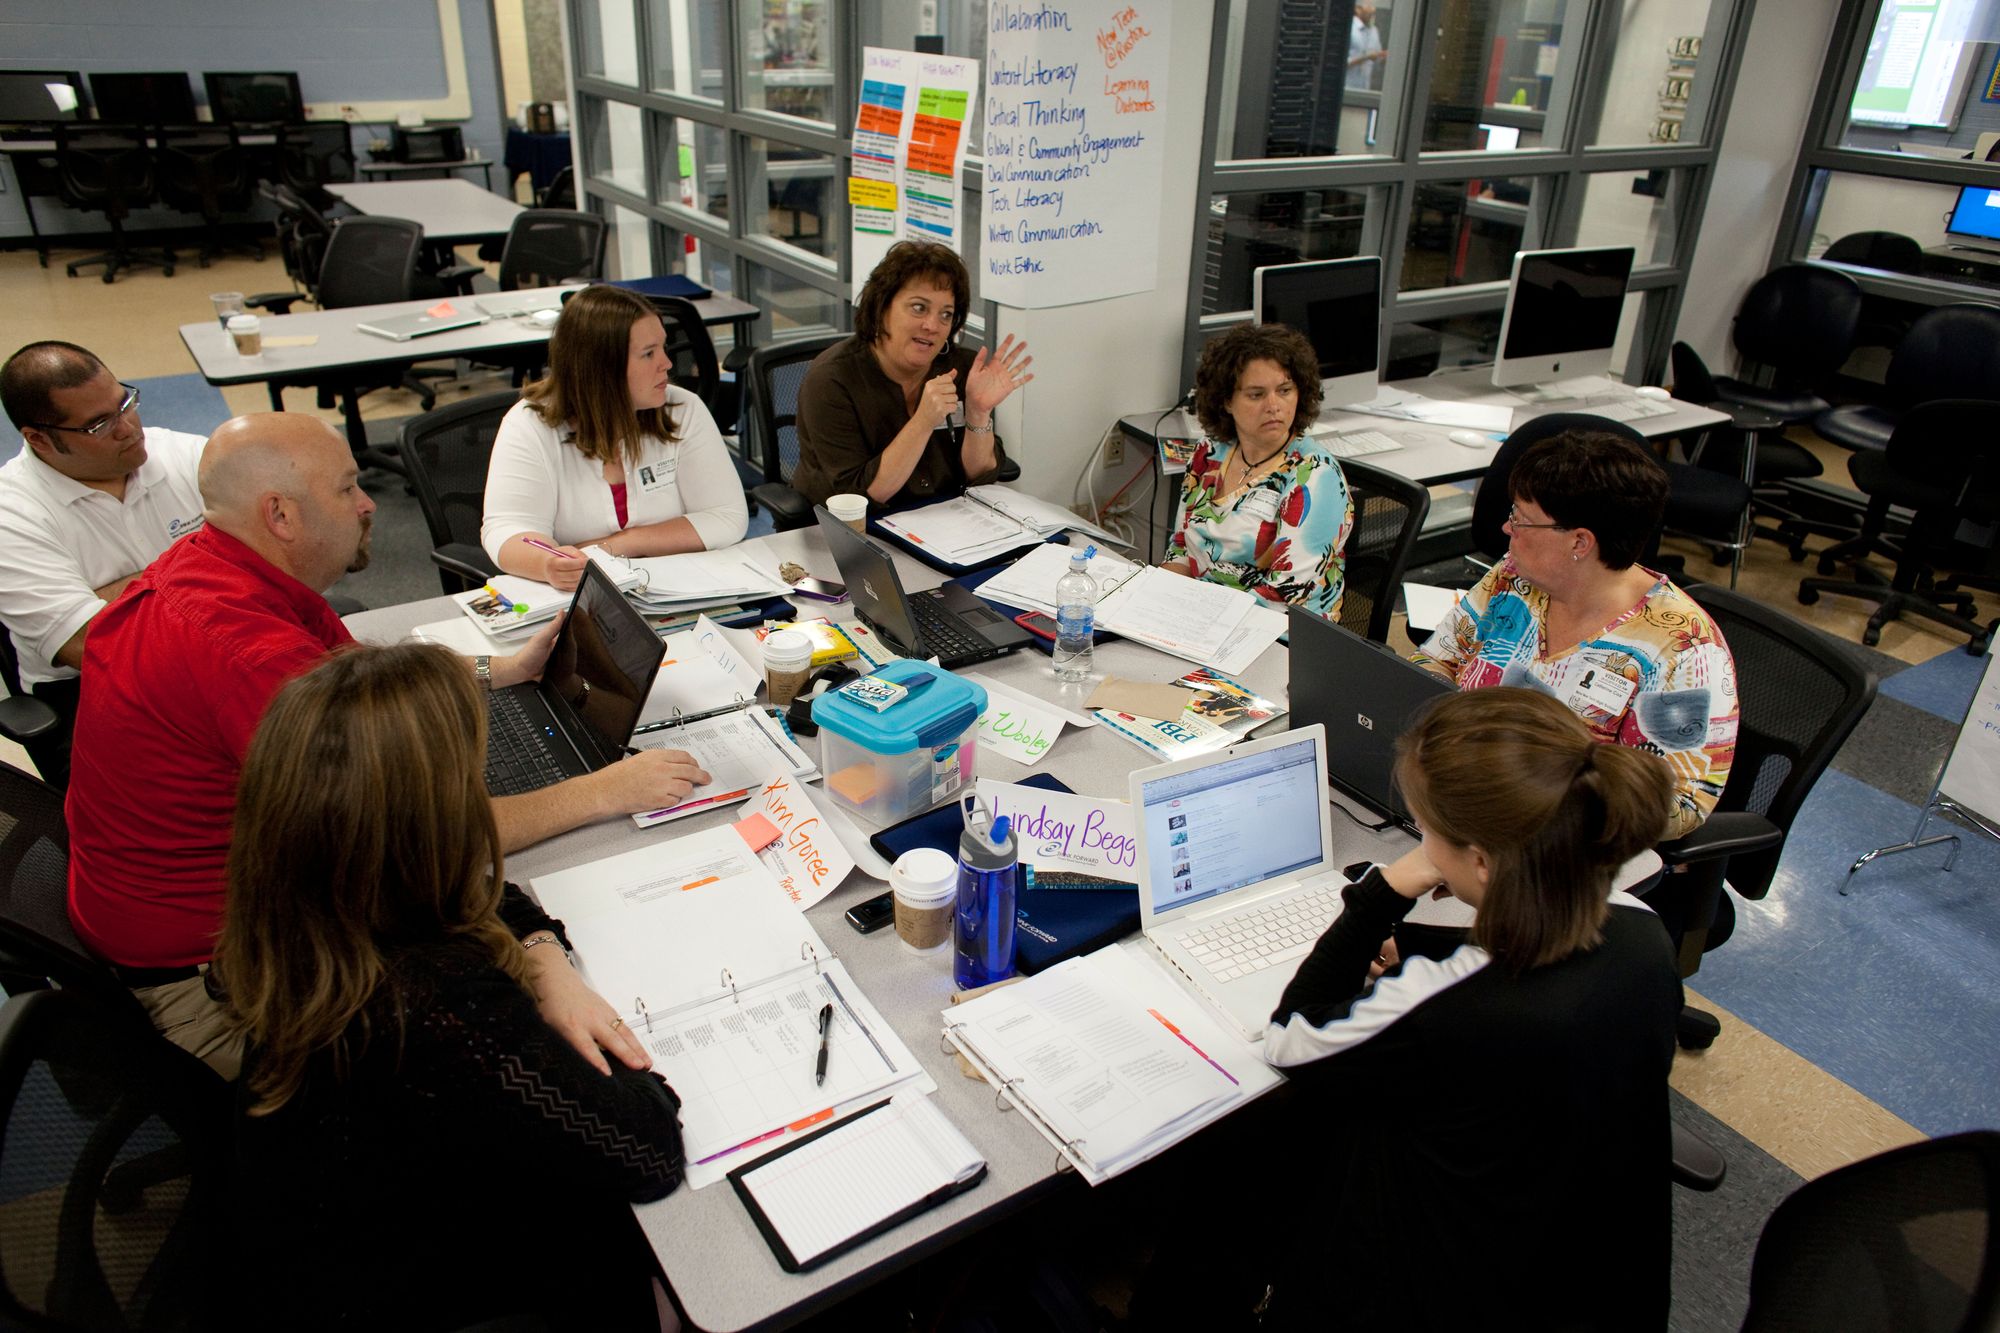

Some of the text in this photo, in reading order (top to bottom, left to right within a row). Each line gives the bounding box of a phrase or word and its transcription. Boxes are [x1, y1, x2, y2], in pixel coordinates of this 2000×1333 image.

[990, 2, 1072, 33] Collaboration
[1097, 6, 1139, 52] New Tech
[989, 49, 1078, 95] Content Literacy
[1104, 75, 1150, 100] Learning
[987, 97, 1020, 127] Critical
[1023, 98, 1085, 135] Thinking
[1115, 96, 1156, 114] Outcomes
[987, 131, 1014, 158] Global
[1029, 136, 1083, 162] Community
[1082, 131, 1145, 164] Engagement
[988, 162, 1090, 183] Oral Communication
[988, 187, 1064, 217] Tech Literacy
[989, 219, 1103, 244] Written Communication
[989, 256, 1045, 275] Work Ethic
[1605, 673, 1628, 686] VISITOR
[992, 712, 1050, 756] Wooley
[762, 776, 795, 830] Kim
[787, 817, 829, 887] Goree
[1073, 853, 1099, 864] FORWARD
